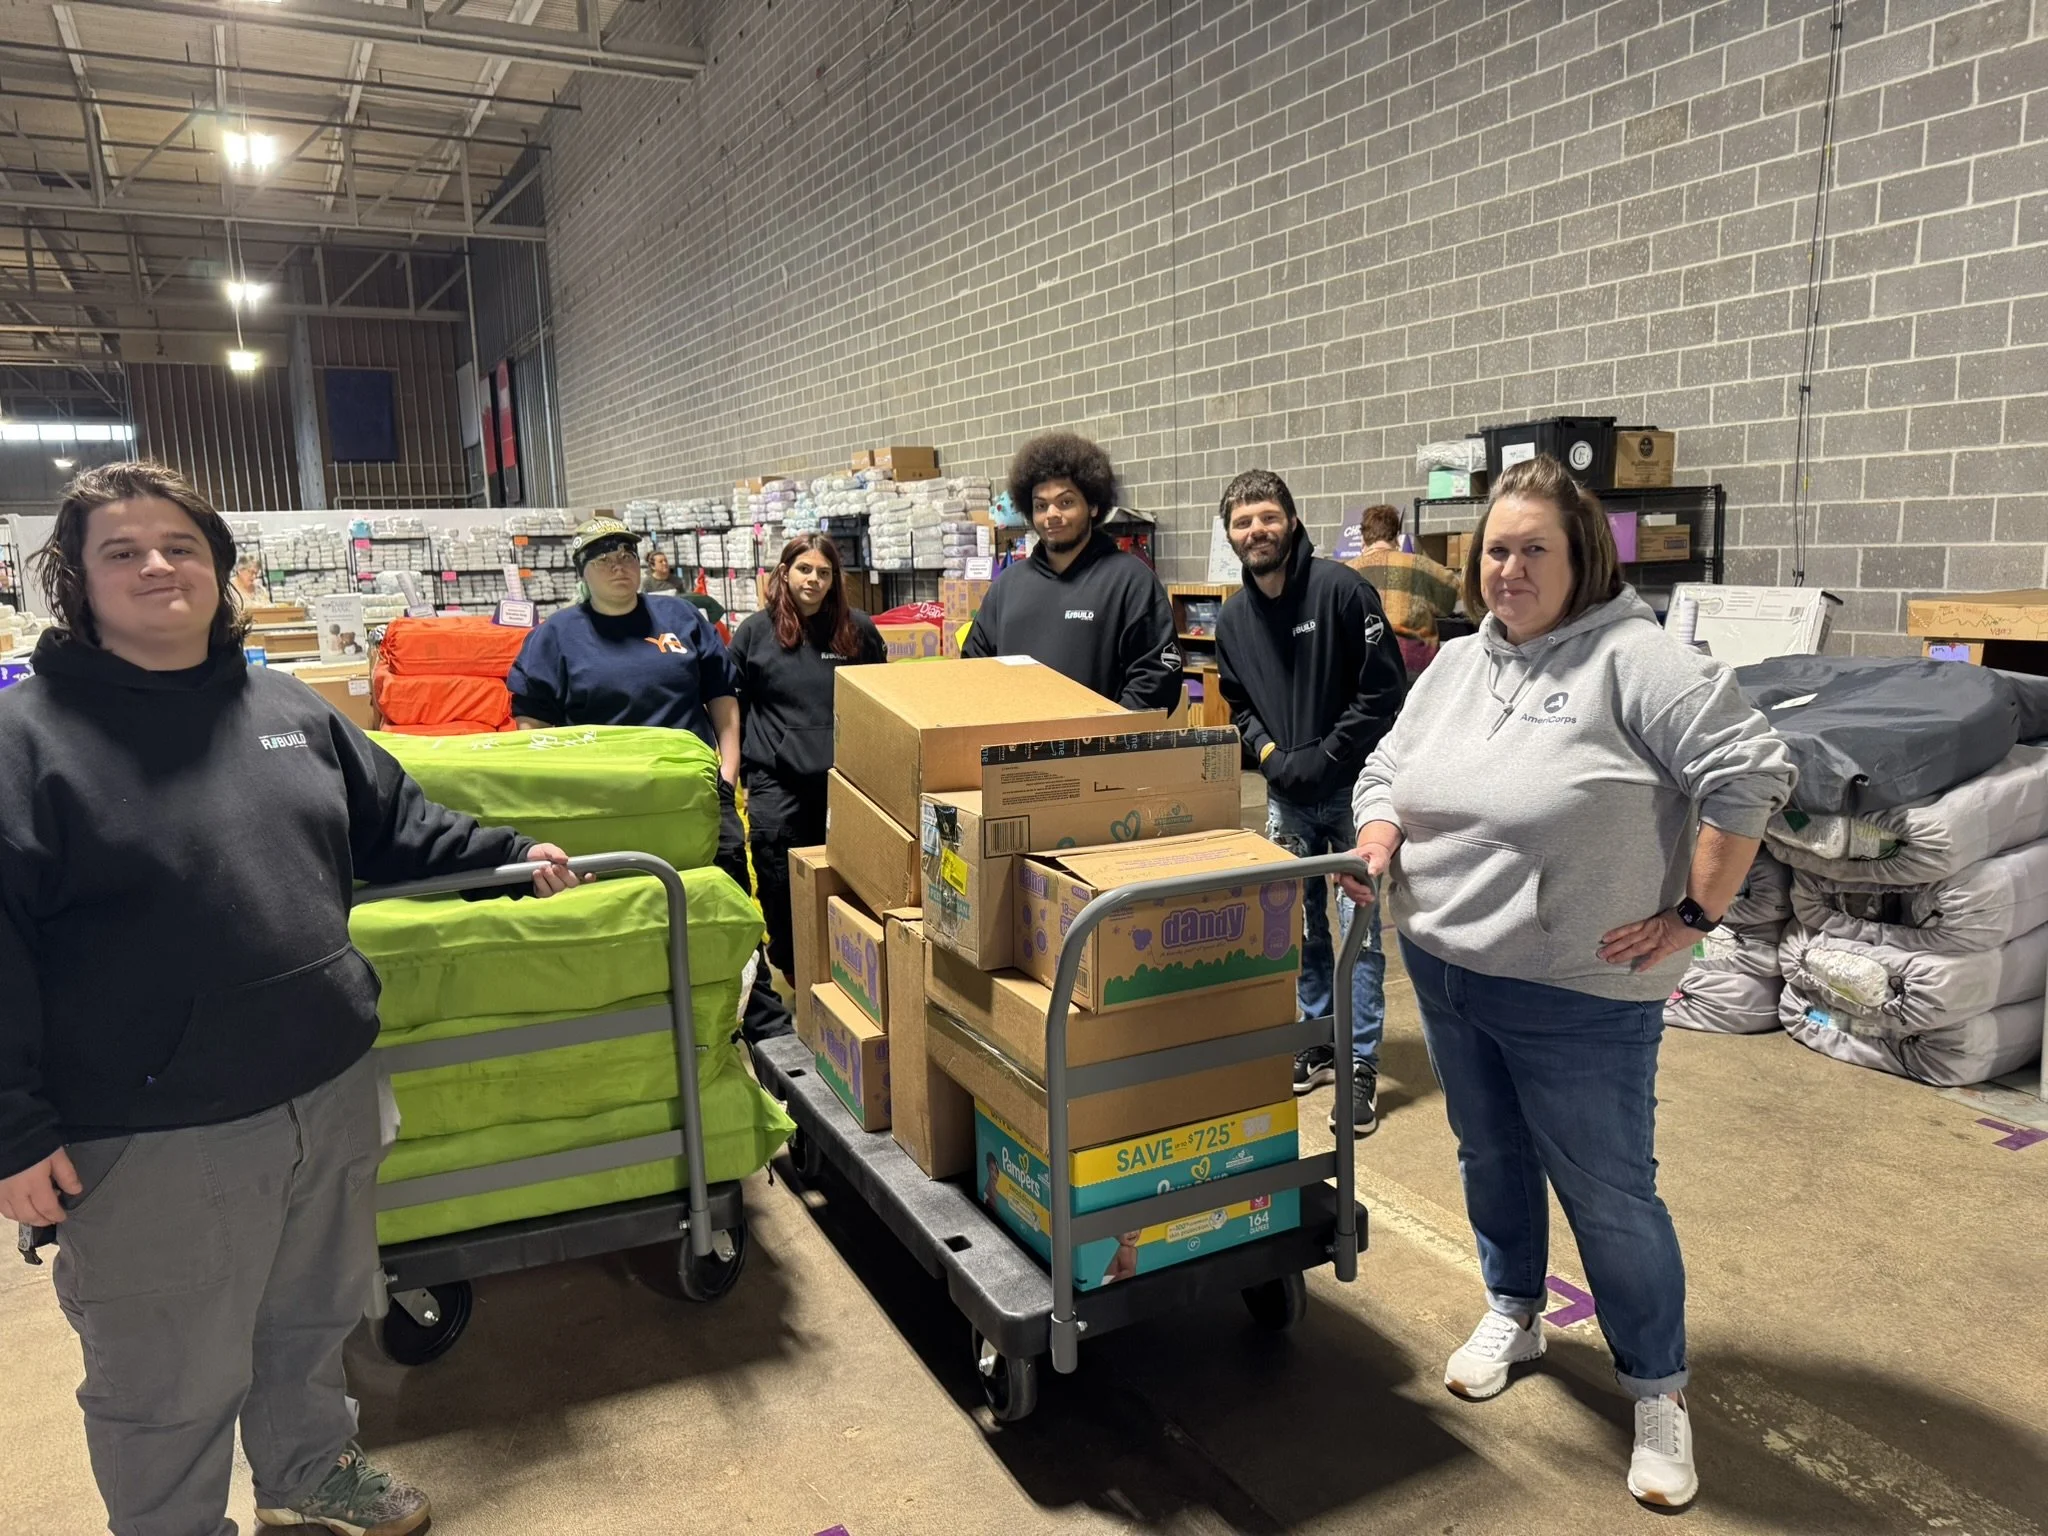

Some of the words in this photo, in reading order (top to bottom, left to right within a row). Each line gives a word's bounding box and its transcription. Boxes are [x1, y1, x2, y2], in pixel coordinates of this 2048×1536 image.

[1520, 713, 1577, 724] AmeriCorps
[1163, 903, 1245, 948] dandy
[1116, 1137, 1174, 1172] SAVE
[1002, 1146, 1040, 1199] Pampers
[1249, 1211, 1269, 1228] 164
